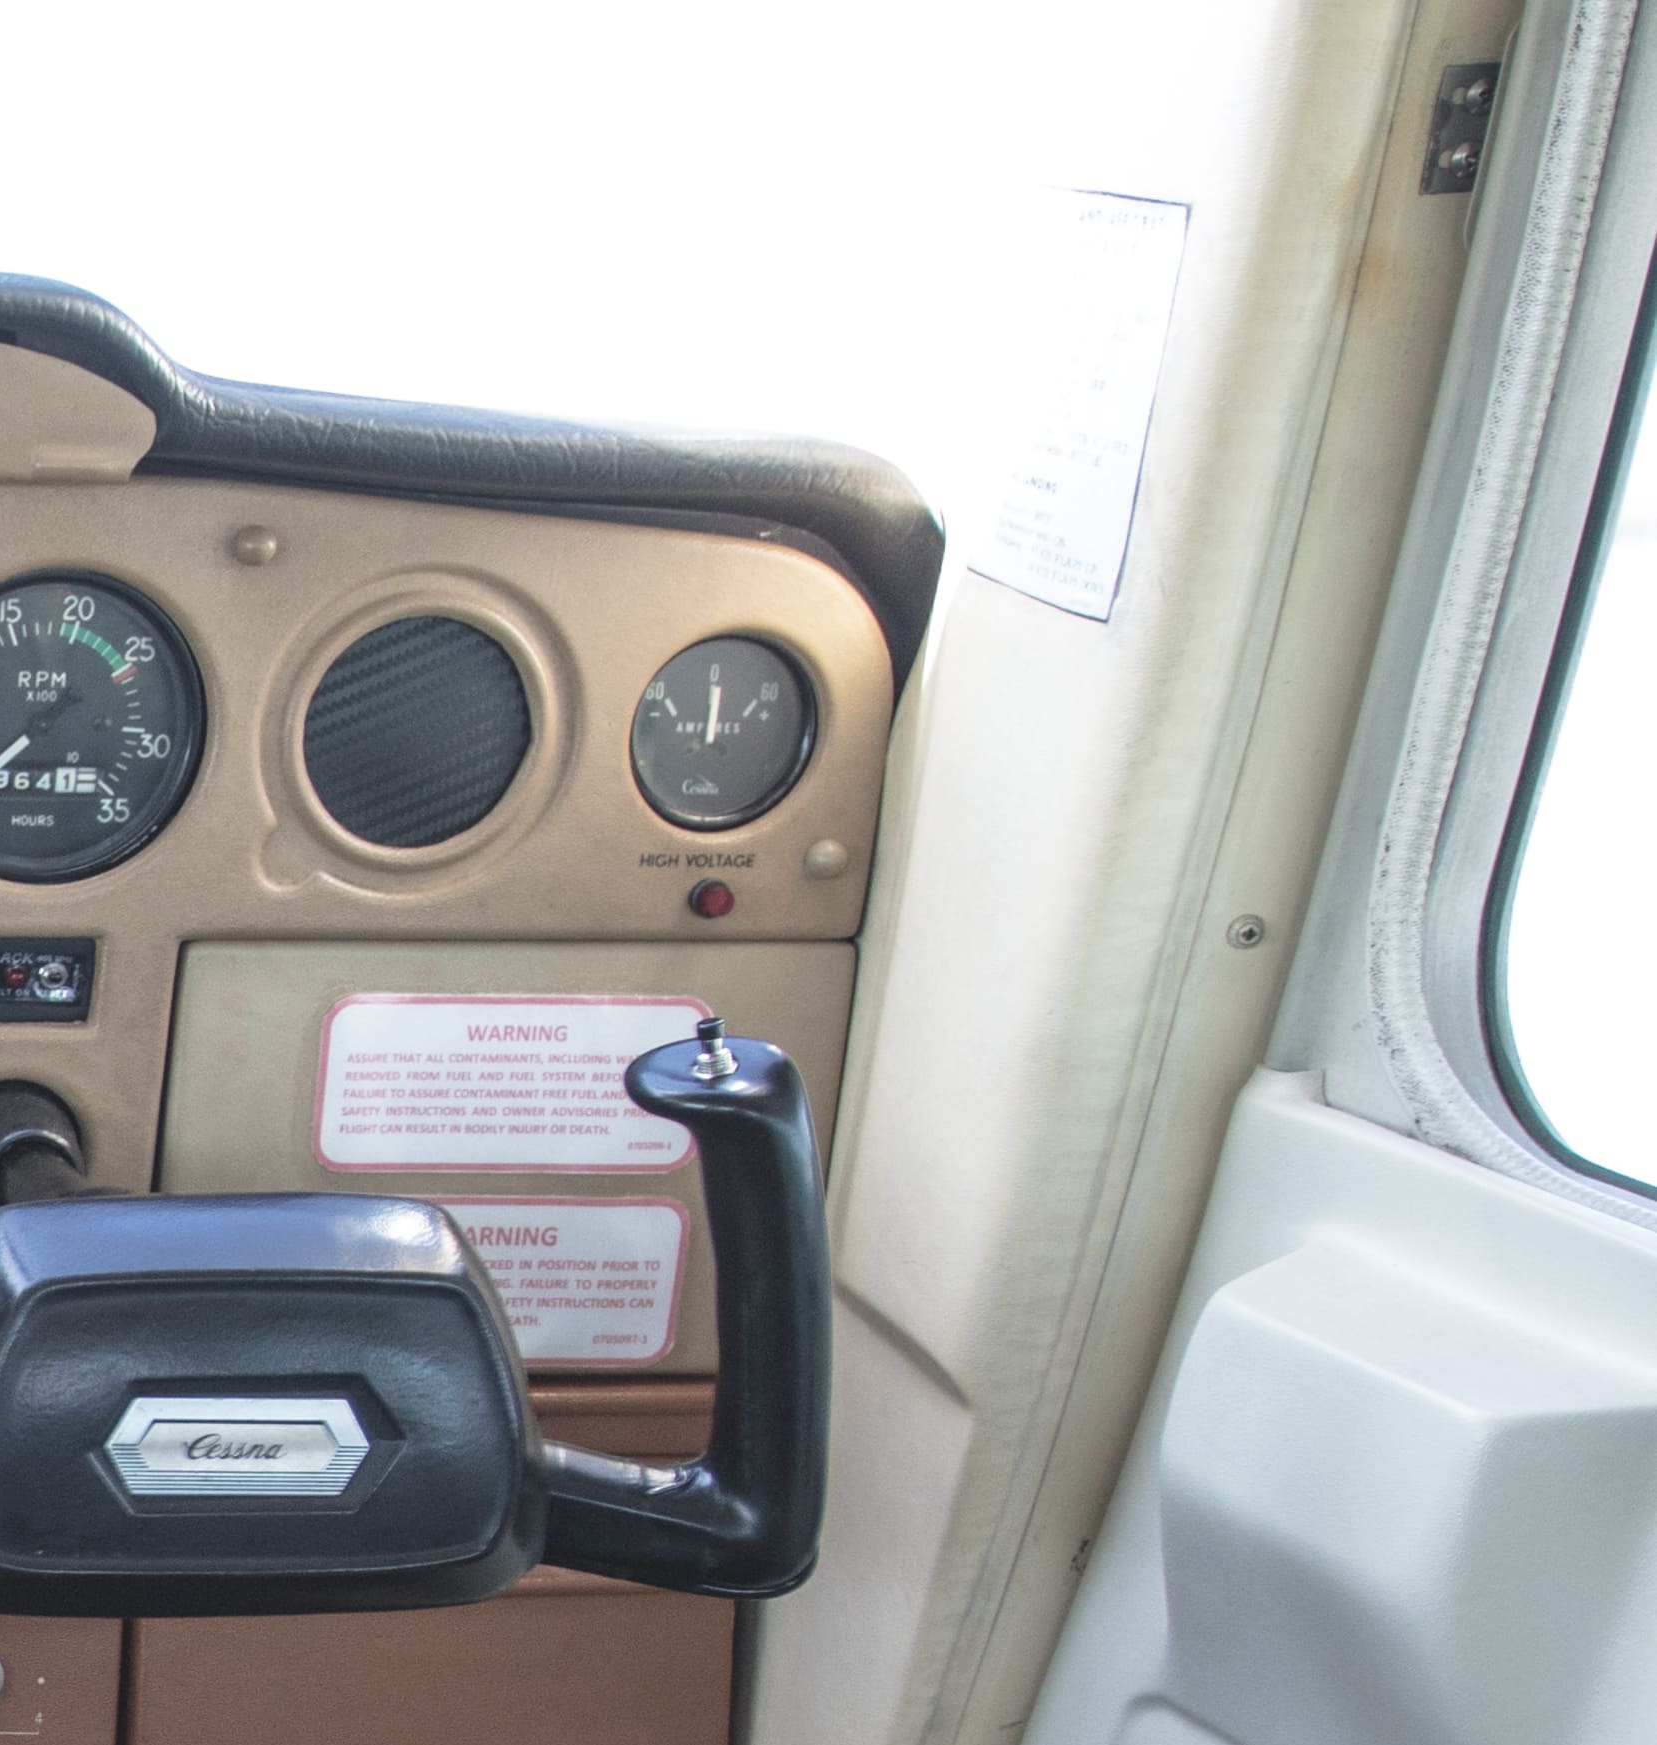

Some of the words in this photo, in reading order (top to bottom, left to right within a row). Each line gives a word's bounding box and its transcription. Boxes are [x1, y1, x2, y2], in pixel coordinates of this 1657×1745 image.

[0, 599, 22, 623] 15
[63, 596, 95, 621] 20
[125, 637, 155, 662] 25
[18, 671, 66, 687] RPM
[137, 734, 171, 758] 30
[12, 815, 54, 826] HOURS
[97, 798, 130, 823] 35
[639, 854, 679, 868] HIGH
[686, 854, 756, 868] VOLTAGE
[468, 1025, 568, 1042] WARNING
[465, 1227, 559, 1246] ARNING
[520, 1279, 568, 1290] FAILURE
[576, 1279, 591, 1290] TO
[597, 1279, 656, 1290] PROPERLY
[185, 1433, 285, 1460] Cessna
